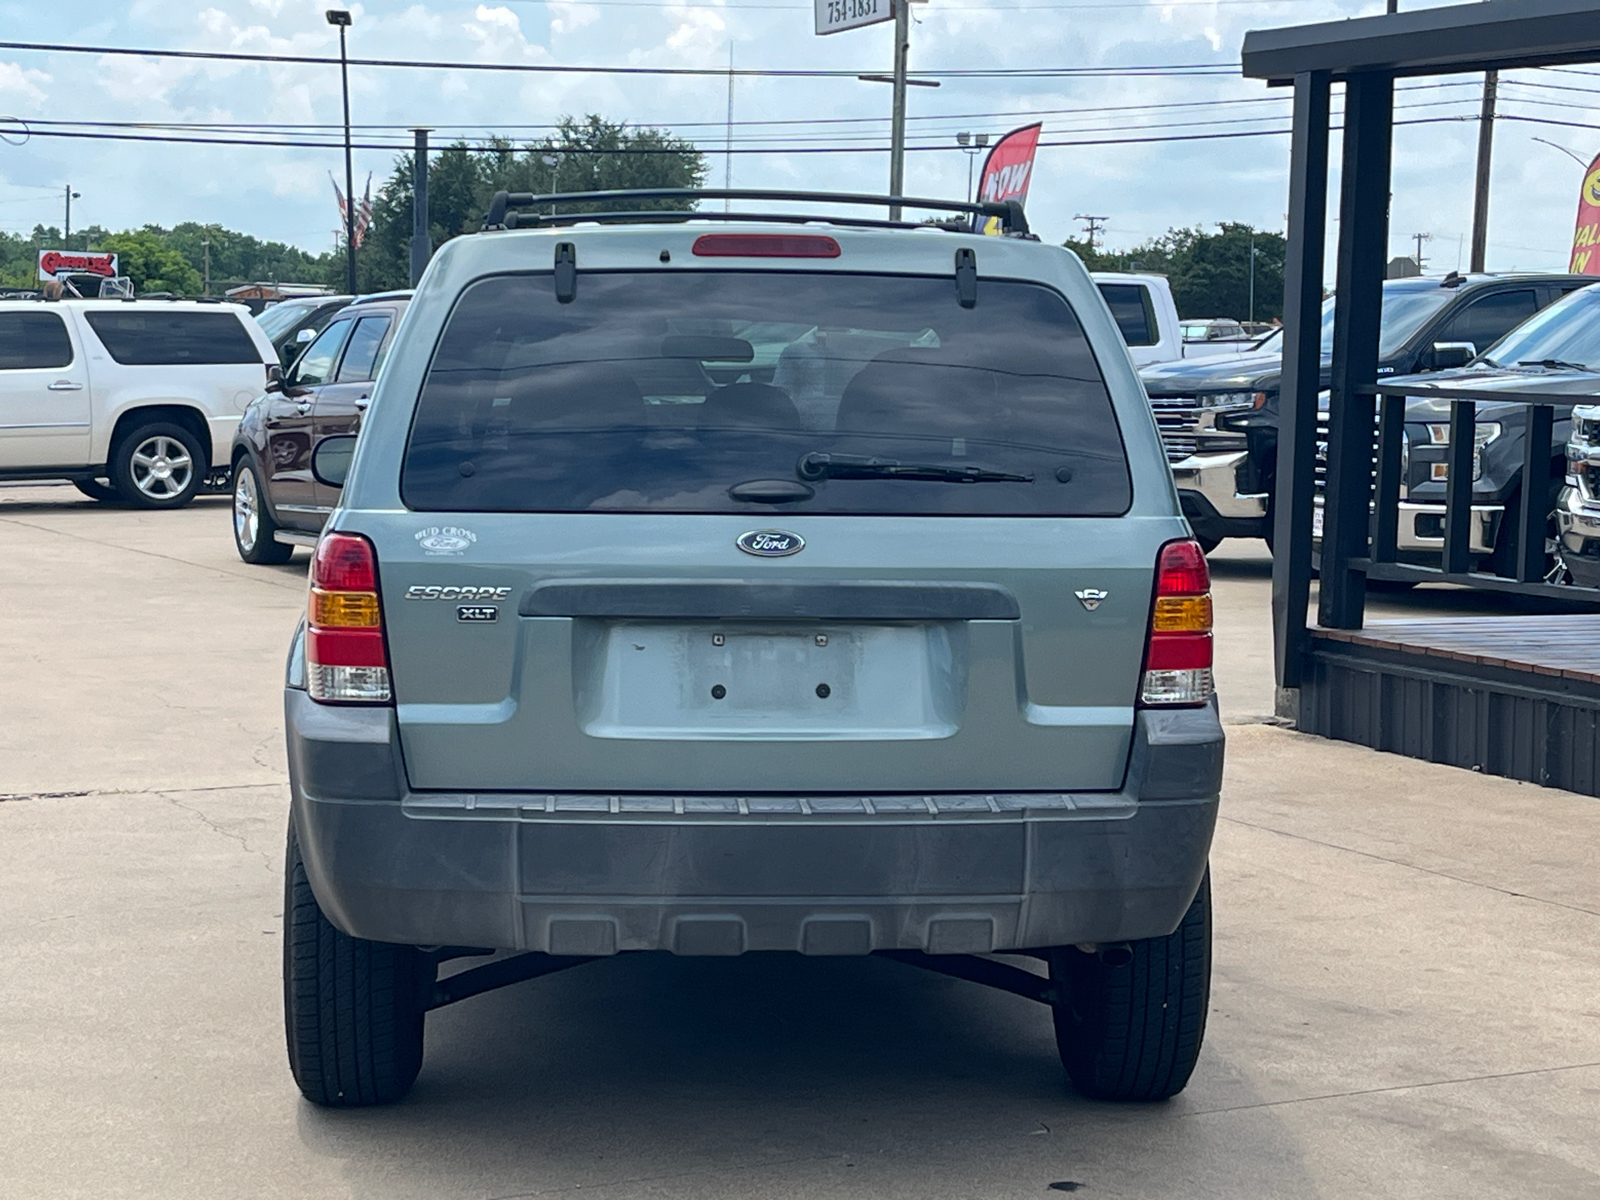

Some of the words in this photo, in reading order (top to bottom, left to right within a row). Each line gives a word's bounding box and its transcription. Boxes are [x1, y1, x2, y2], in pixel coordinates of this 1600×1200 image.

[828, 0, 878, 24] 754-1831
[984, 161, 1031, 202] NOW
[442, 526, 477, 543] CROSS
[752, 534, 790, 550] Ford
[404, 585, 512, 600] ESCAPE
[461, 608, 495, 619] XLT
